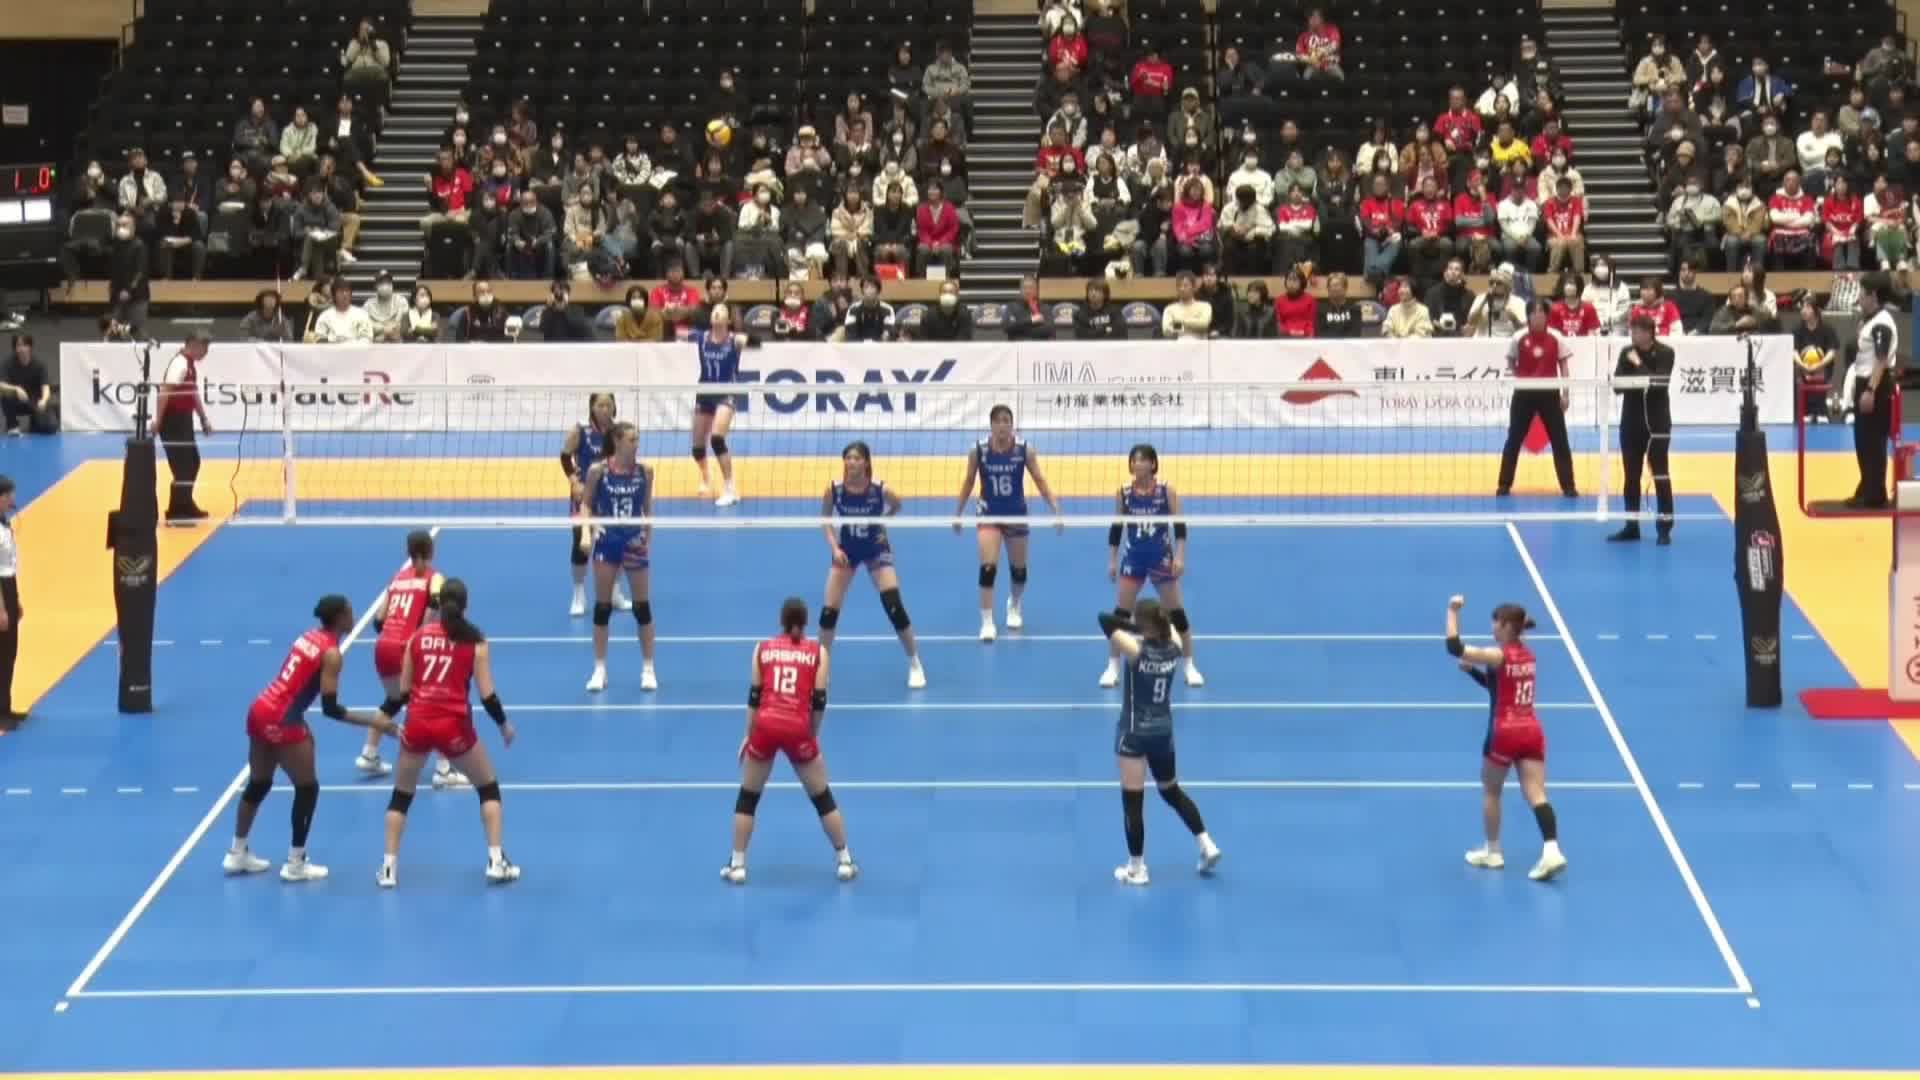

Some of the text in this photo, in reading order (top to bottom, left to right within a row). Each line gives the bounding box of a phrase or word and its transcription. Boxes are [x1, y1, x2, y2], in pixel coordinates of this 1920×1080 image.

[733, 360, 957, 414] TORAY
[1035, 392, 1184, 408] 一村産業株式会社
[989, 475, 1013, 497] 16
[281, 655, 302, 682] 5
[422, 655, 453, 683] 77
[773, 666, 798, 695] 12
[1153, 677, 1168, 704] 9
[1514, 680, 1534, 704] 10
